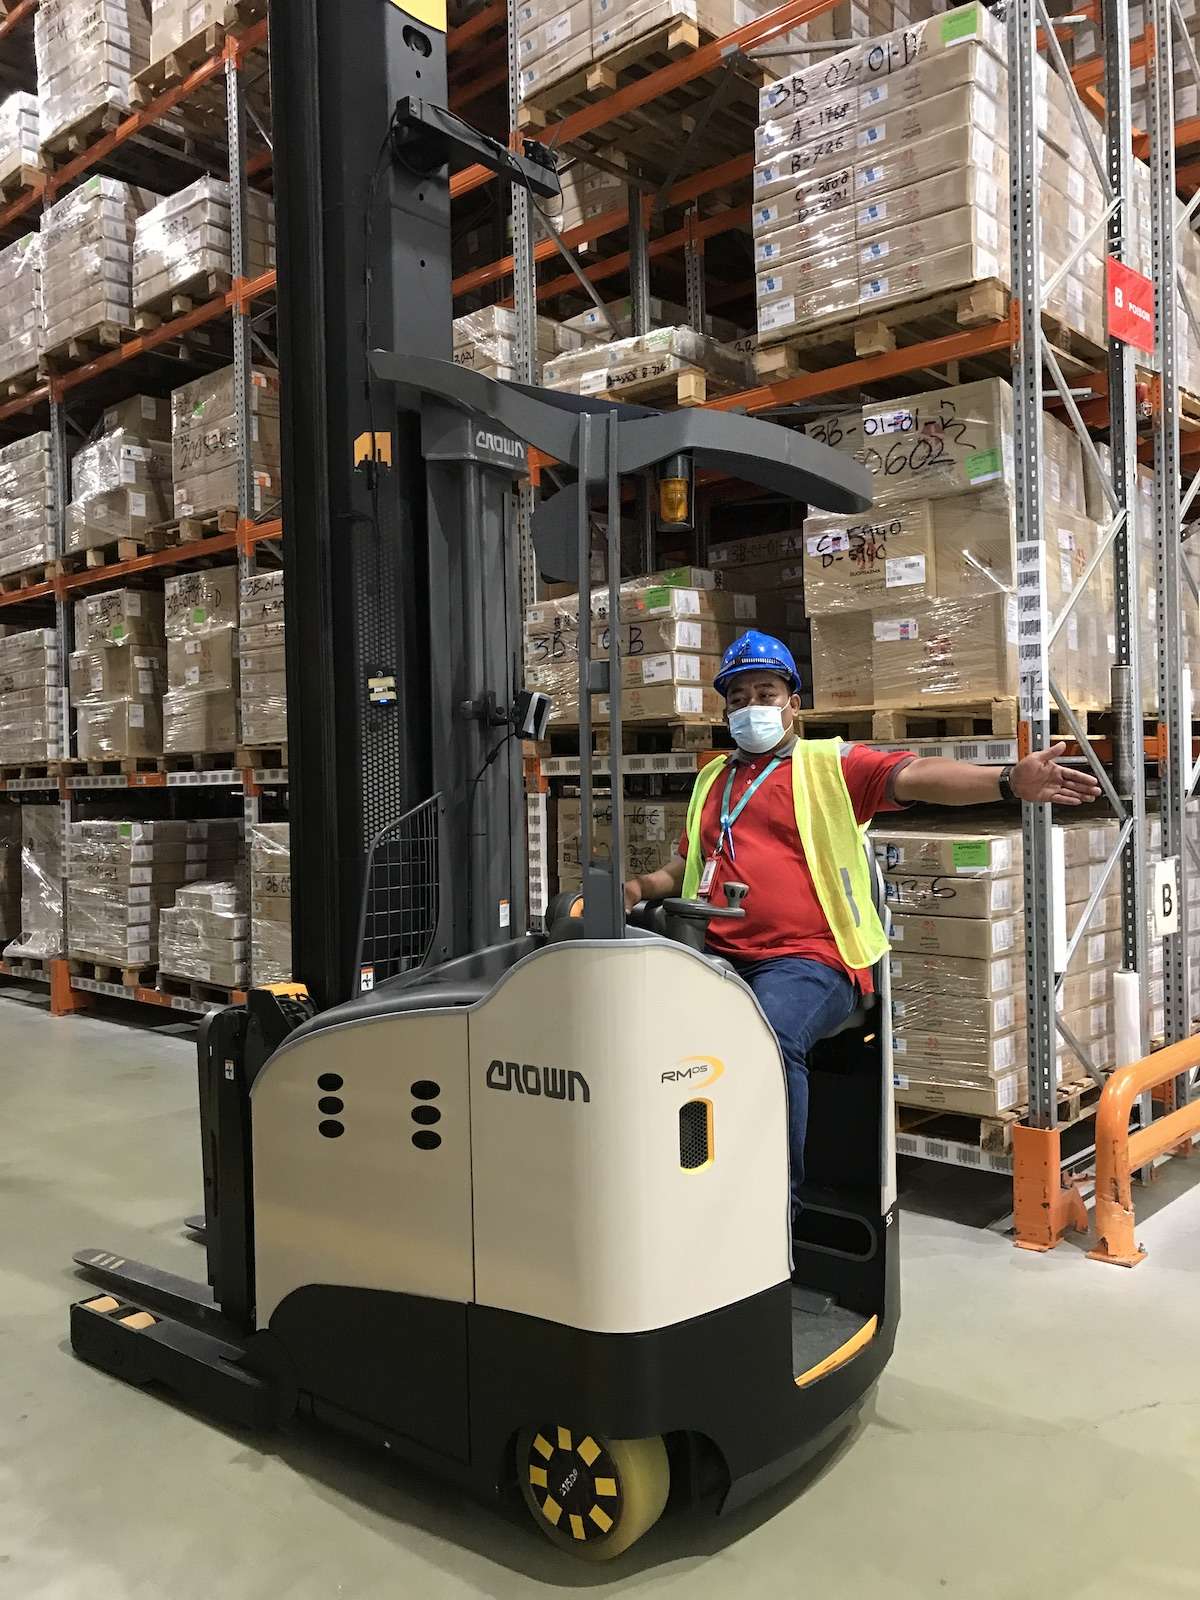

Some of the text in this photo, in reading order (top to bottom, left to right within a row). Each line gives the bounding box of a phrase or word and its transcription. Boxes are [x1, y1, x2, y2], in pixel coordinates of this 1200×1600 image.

[1114, 286, 1123, 308] B
[476, 430, 524, 459] CROWN
[1162, 884, 1173, 917] B
[486, 1059, 590, 1102] CROWN
